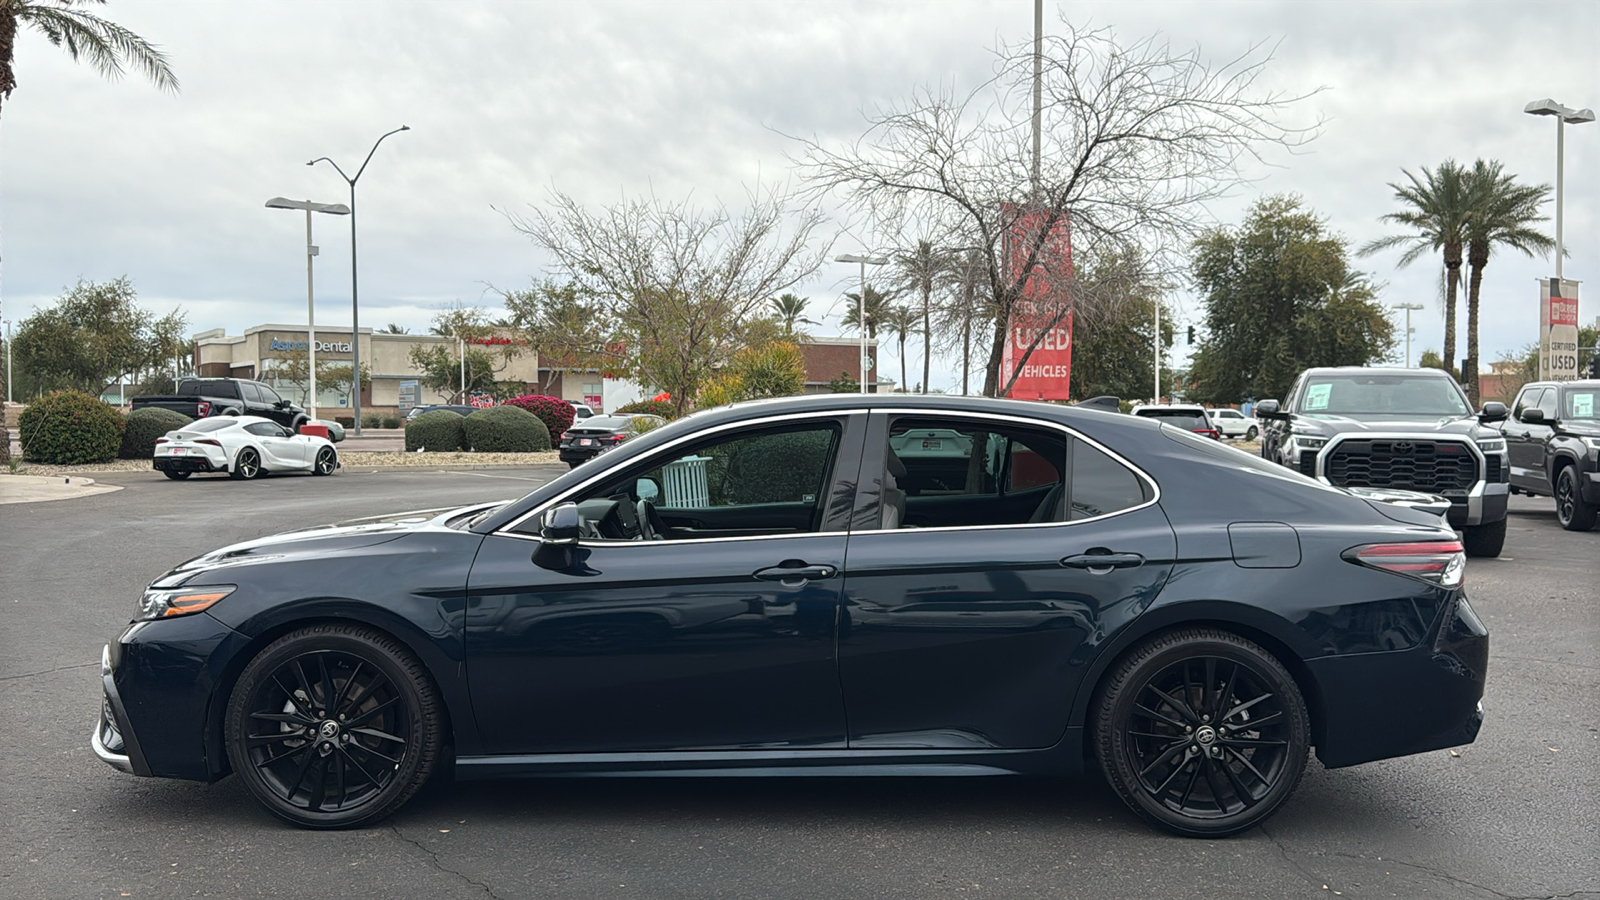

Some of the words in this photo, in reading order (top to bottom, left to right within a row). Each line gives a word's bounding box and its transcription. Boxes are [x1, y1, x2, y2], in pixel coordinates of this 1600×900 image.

[1015, 327, 1070, 351] USED
[314, 340, 353, 353] Dental
[1551, 342, 1576, 352] CERTIFIED
[1551, 354, 1576, 370] USED
[1016, 364, 1067, 378] VEHICLES
